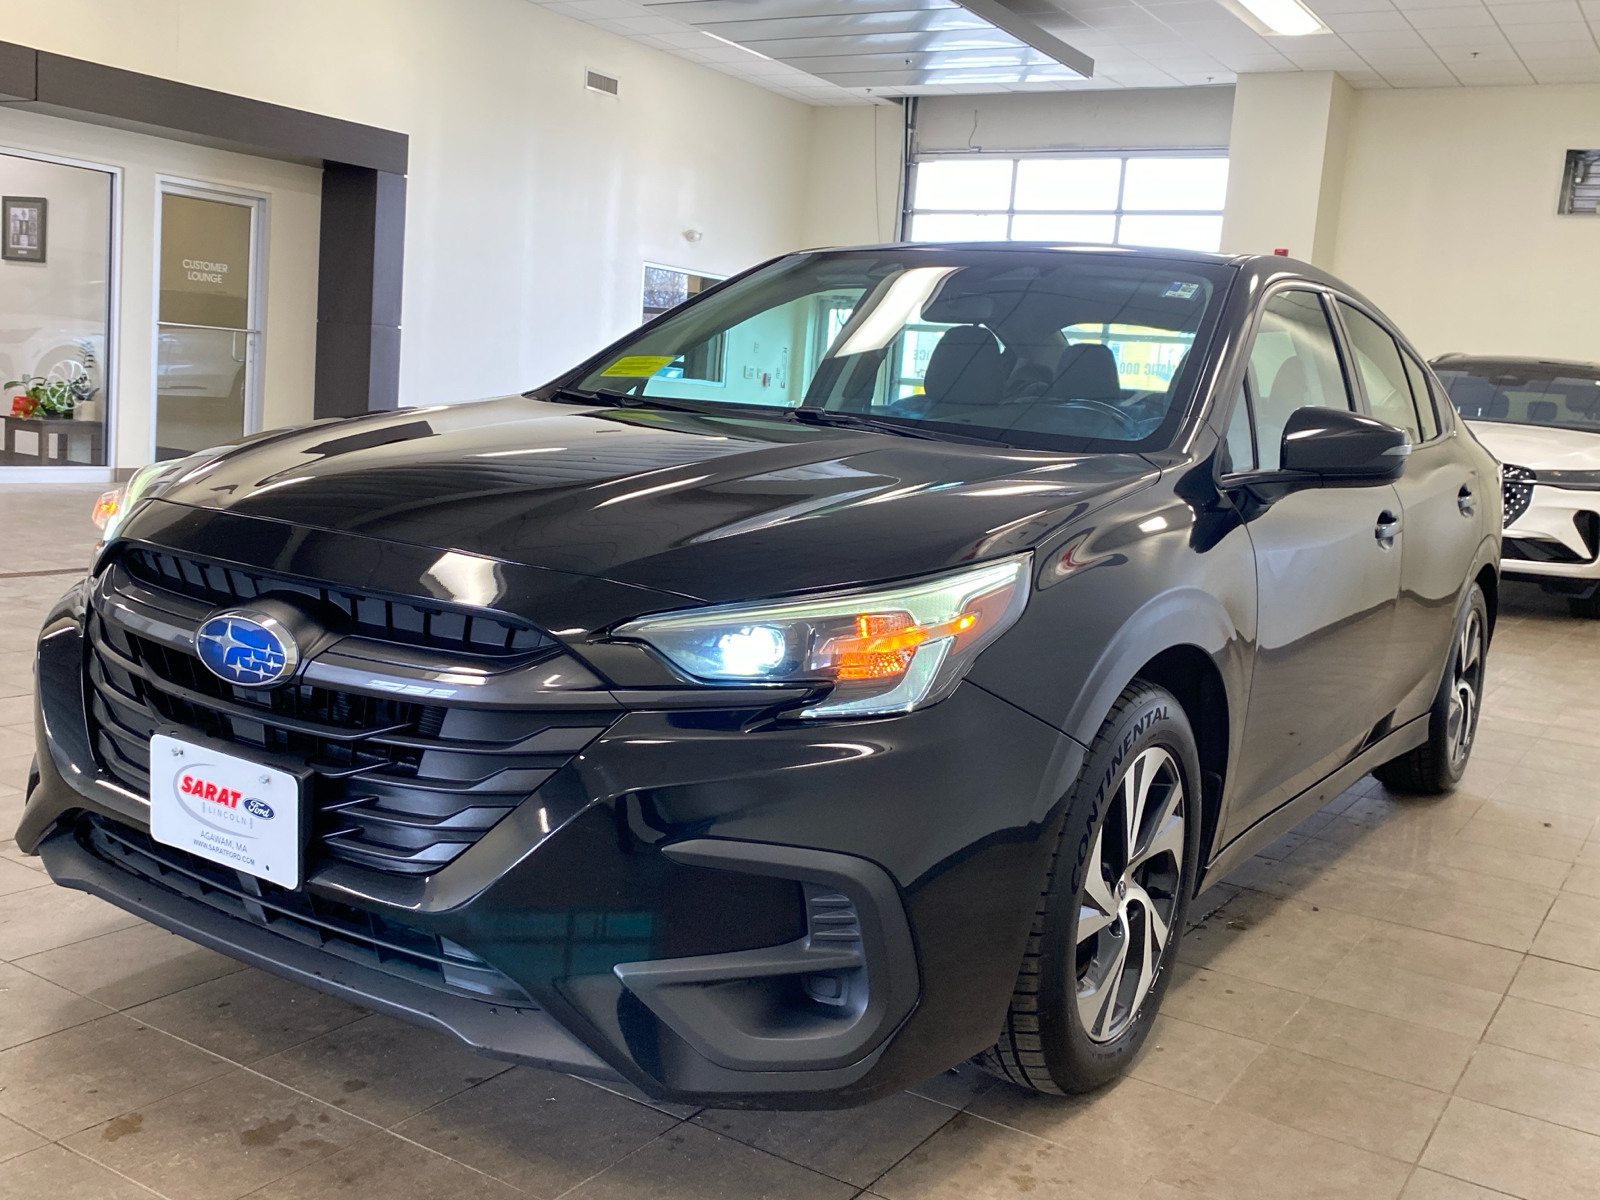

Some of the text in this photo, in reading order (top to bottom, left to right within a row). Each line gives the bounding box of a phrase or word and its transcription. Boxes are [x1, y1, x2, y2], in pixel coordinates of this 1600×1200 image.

[183, 259, 228, 273] CUSTOMER
[188, 271, 222, 283] LOUNGE
[181, 776, 241, 809] SARAT
[1071, 706, 1170, 896] CONTINENTAL
[208, 806, 247, 825] LINCOLN
[248, 800, 270, 817] Ford
[193, 839, 256, 866] WWW.SARATFORD.COM
[200, 830, 248, 854] AGAWAM, MA
